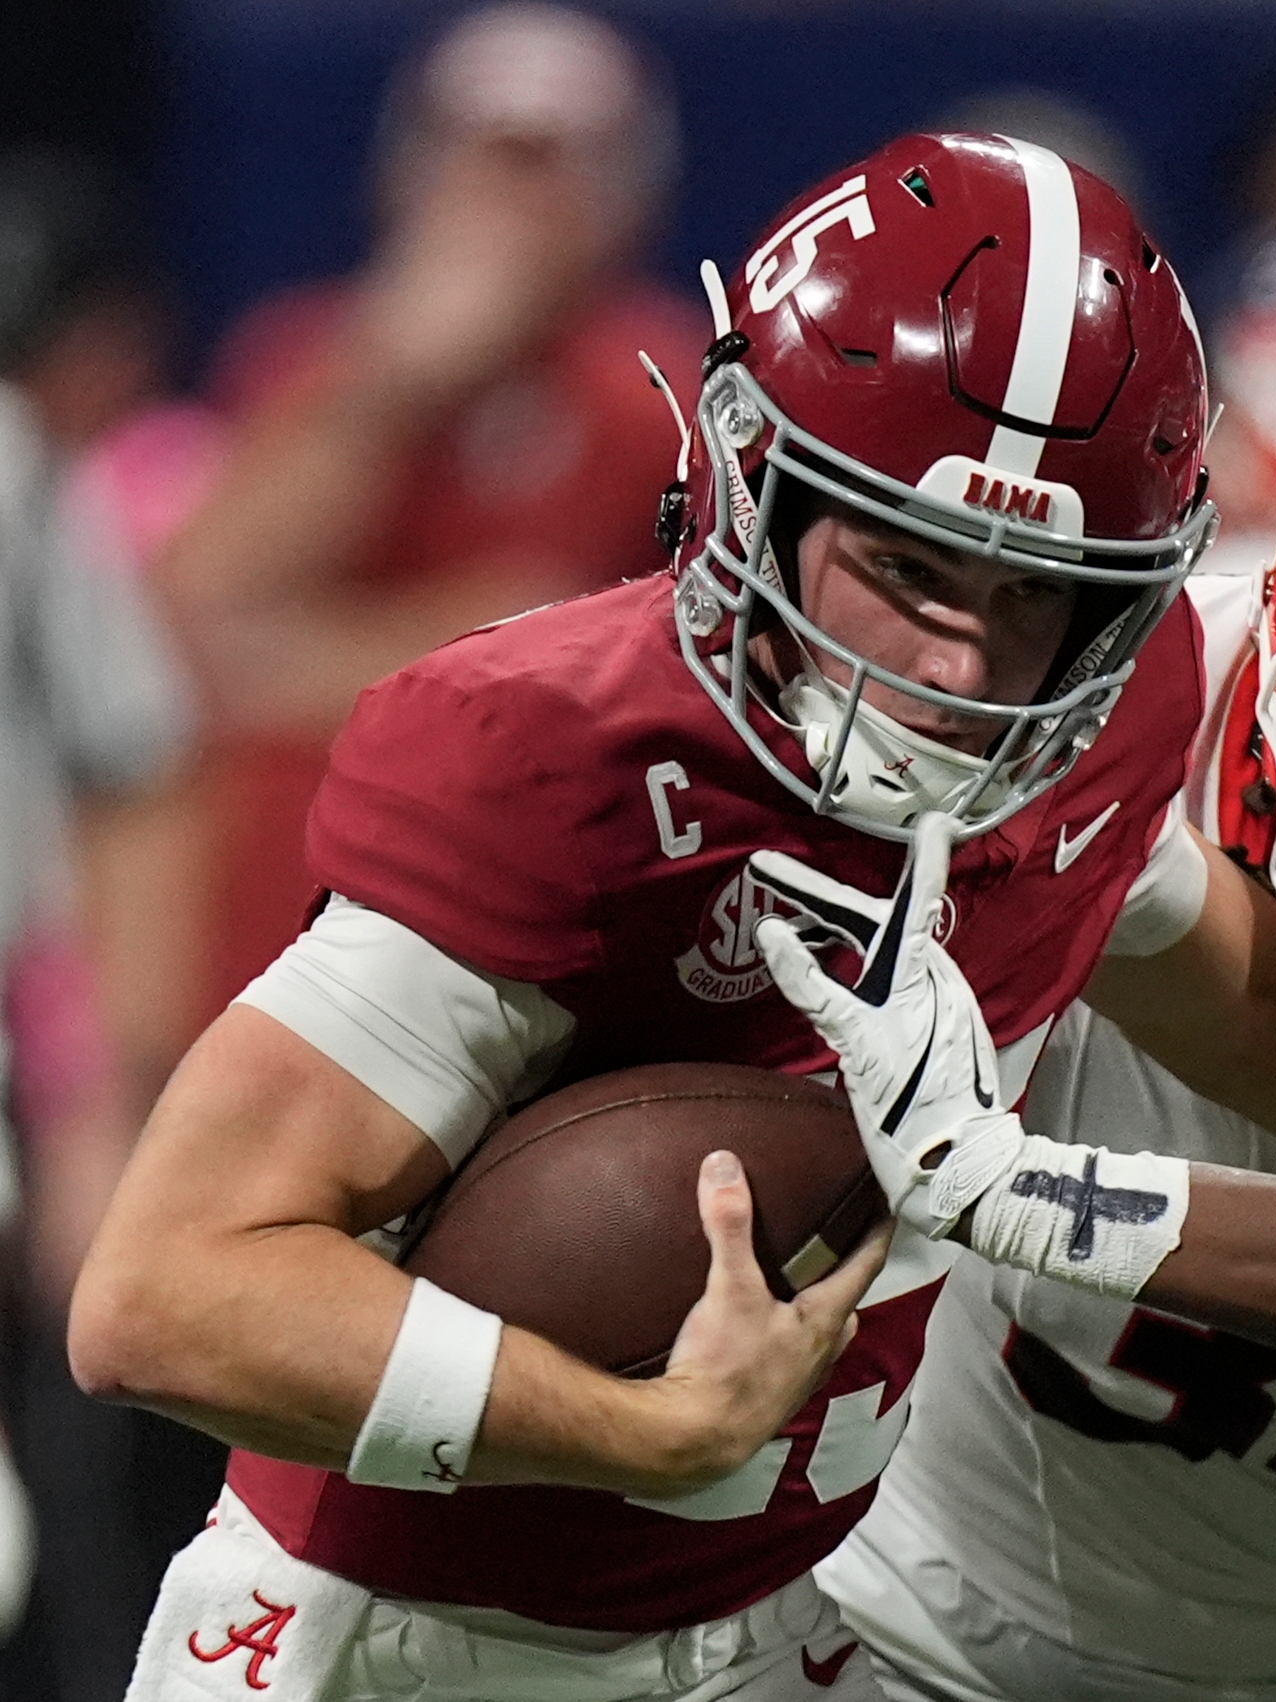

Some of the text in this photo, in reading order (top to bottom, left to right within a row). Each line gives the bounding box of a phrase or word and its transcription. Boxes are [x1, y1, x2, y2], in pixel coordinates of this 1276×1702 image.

[745, 173, 876, 314] 15
[645, 760, 702, 859] C
[688, 966, 776, 999] GRADUA
[188, 1589, 297, 1690] A
